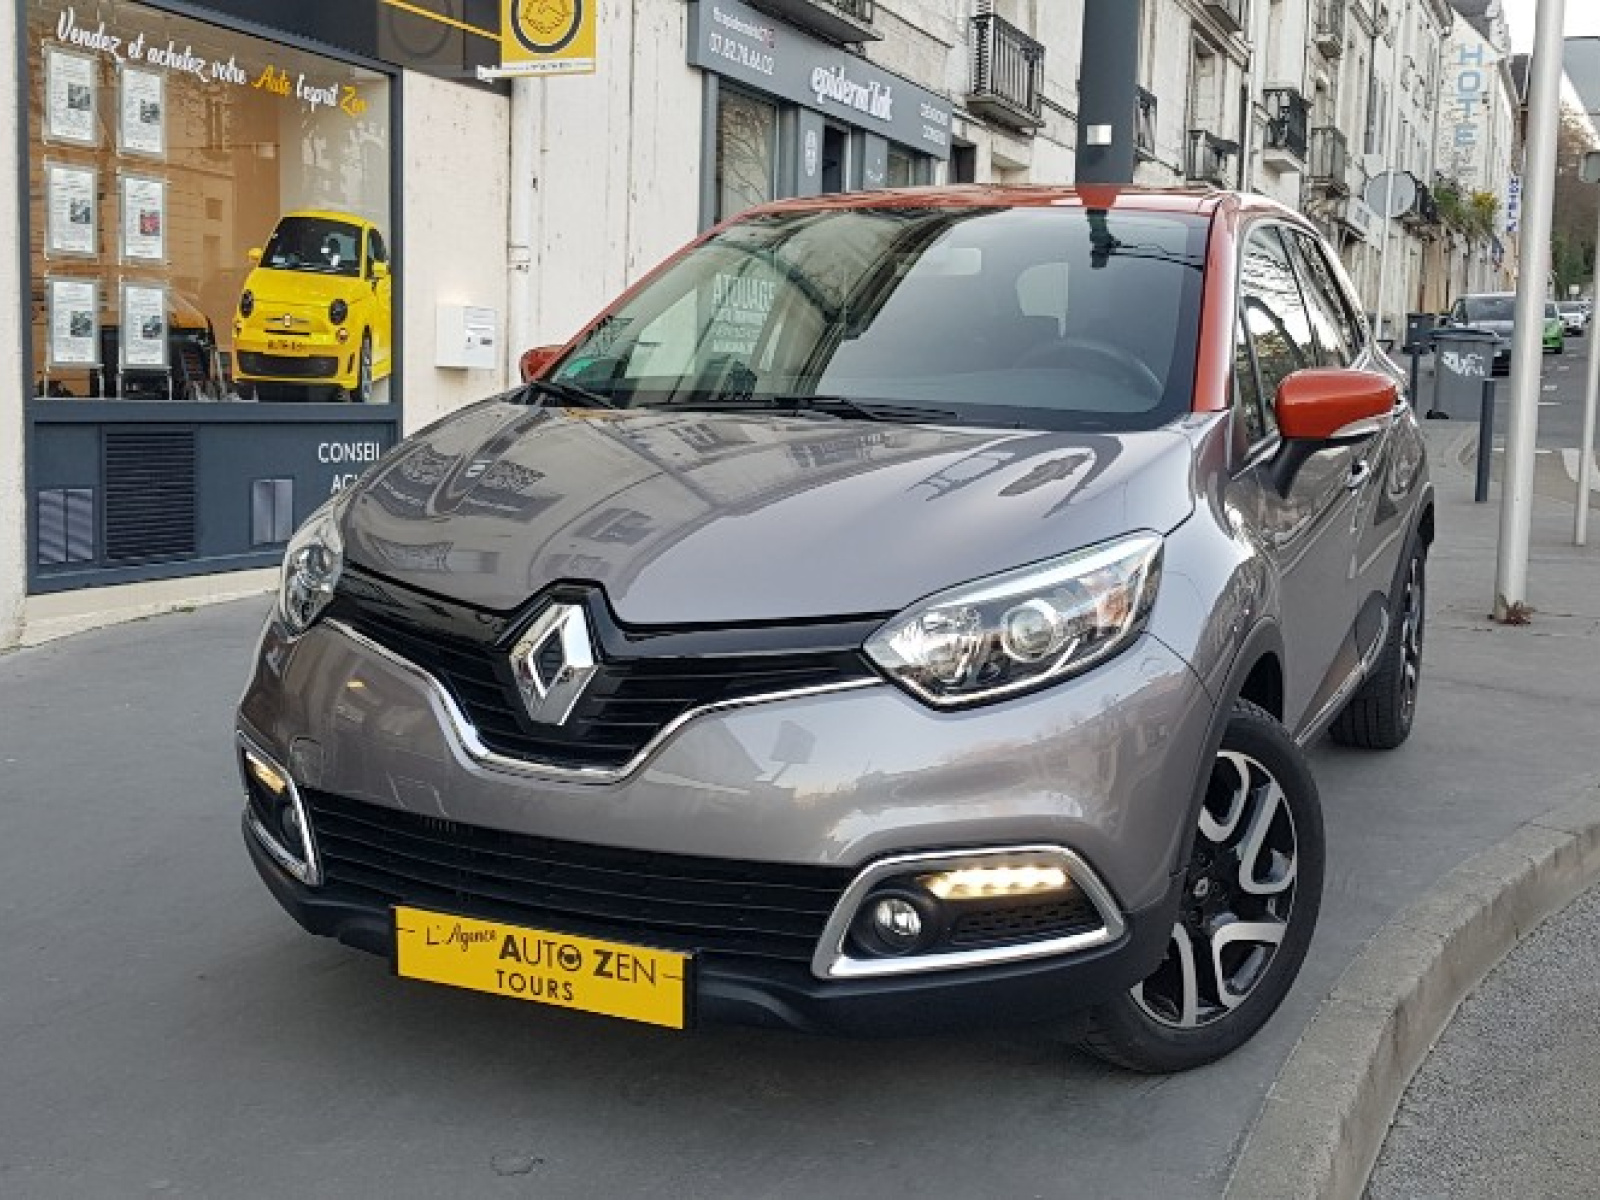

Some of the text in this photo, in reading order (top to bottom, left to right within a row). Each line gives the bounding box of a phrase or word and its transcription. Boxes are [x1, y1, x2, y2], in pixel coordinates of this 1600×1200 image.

[57, 6, 126, 63] Vendez
[128, 31, 144, 59] et
[147, 40, 210, 83] achetez
[212, 55, 247, 85] votre
[341, 84, 367, 117] Zen
[496, 968, 575, 1001] TOURS
[499, 934, 582, 973] AUTO
[593, 948, 657, 987] ZEN
